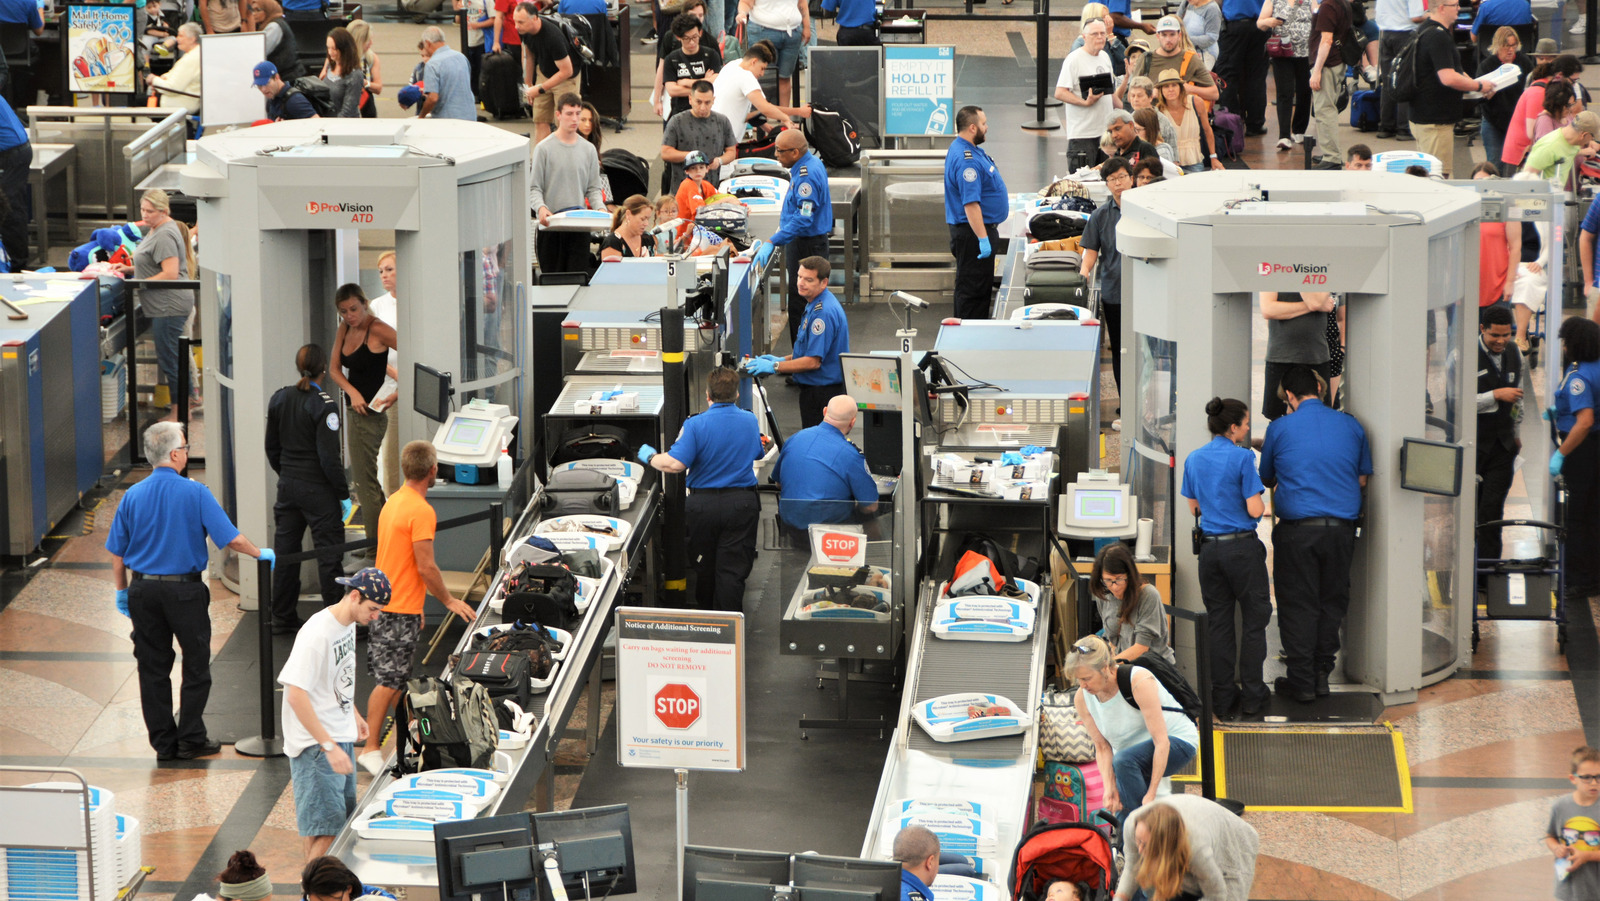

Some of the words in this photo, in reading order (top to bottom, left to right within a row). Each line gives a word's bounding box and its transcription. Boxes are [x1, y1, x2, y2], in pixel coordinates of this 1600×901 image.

[72, 11, 90, 20] Mail
[93, 11, 99, 20] It
[101, 11, 129, 20] Home
[72, 20, 101, 30] Safely!
[891, 61, 933, 72] EMPTY
[936, 61, 947, 72] IT
[891, 73, 930, 84] HOLD
[933, 73, 947, 84] IT
[891, 85, 932, 95] REFILL
[936, 85, 947, 95] IT
[320, 203, 374, 213] ProVision
[351, 213, 374, 223] ATD
[668, 262, 675, 276] 5
[1273, 263, 1328, 273] ProVision
[1302, 274, 1327, 285] ATD
[902, 338, 909, 353] 6
[825, 539, 856, 550] STOP
[625, 621, 646, 629] Notice
[647, 622, 654, 630] of
[655, 623, 689, 631] Additional
[690, 625, 722, 634] Screening
[651, 645, 665, 653] bags
[666, 646, 689, 654] waiting
[662, 655, 692, 663] screening
[657, 697, 698, 715] STOP
[632, 736, 649, 744] Your
[650, 737, 672, 746] safety
[695, 740, 724, 748] priority
